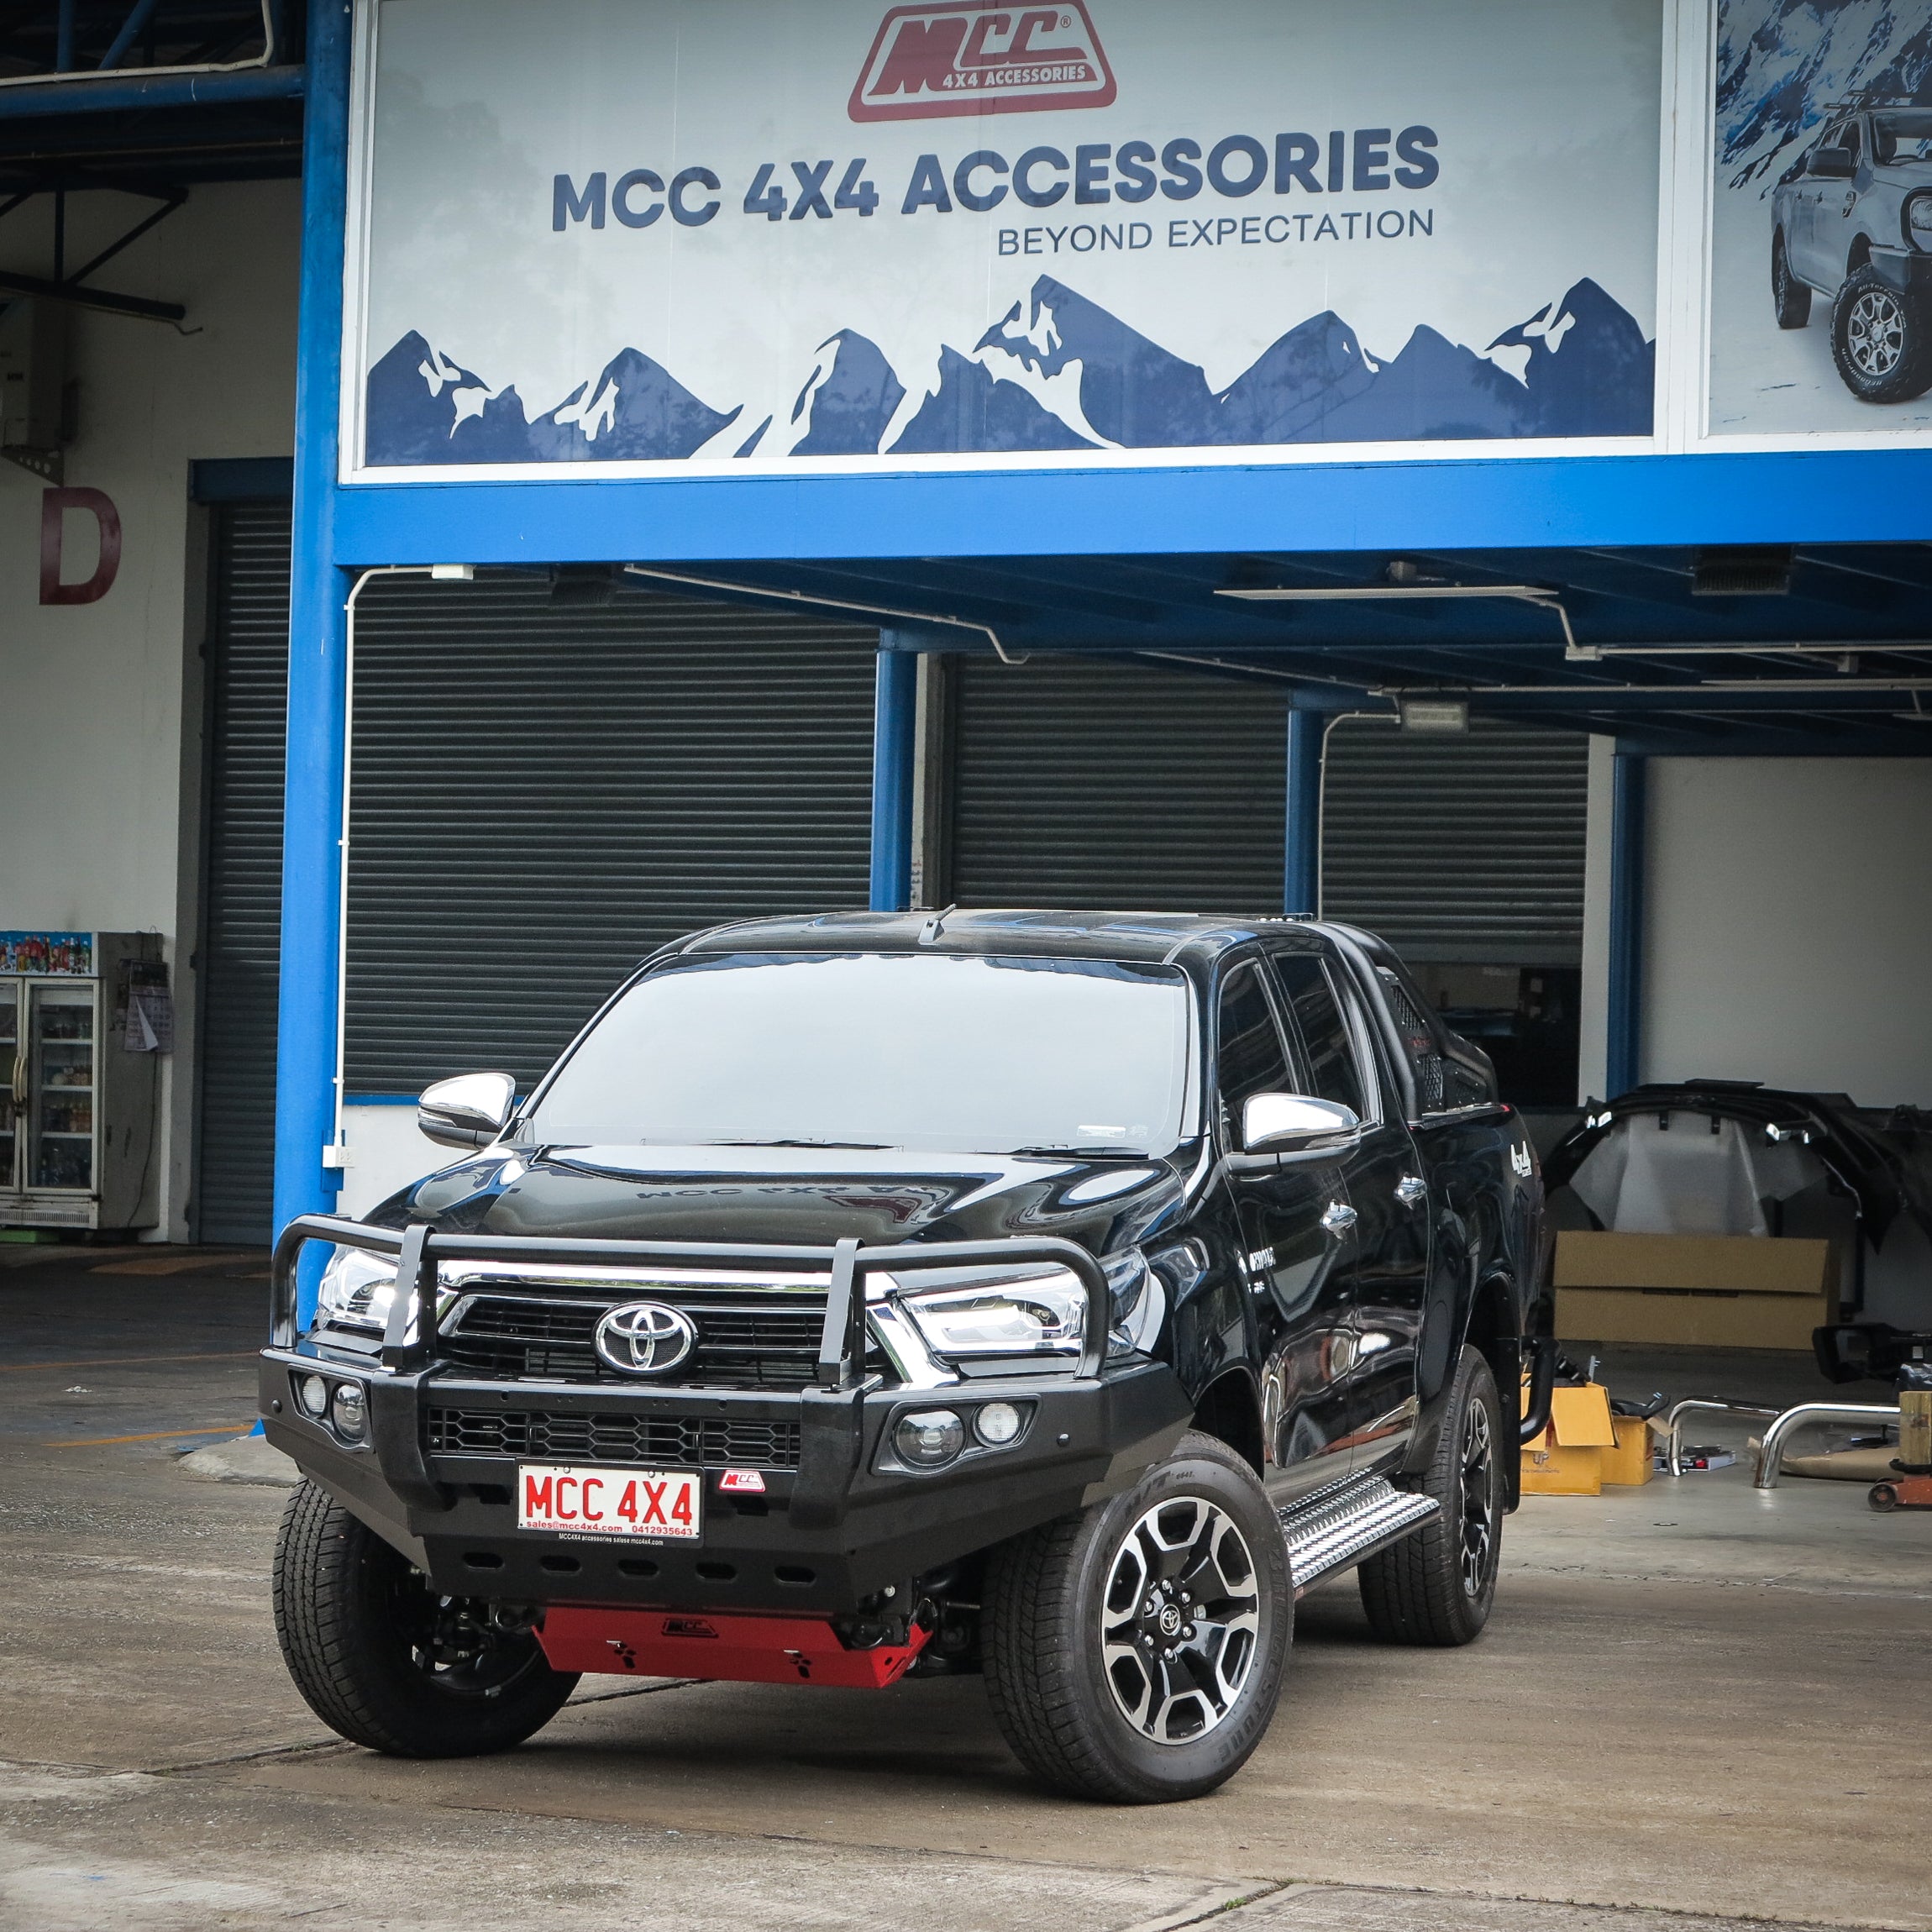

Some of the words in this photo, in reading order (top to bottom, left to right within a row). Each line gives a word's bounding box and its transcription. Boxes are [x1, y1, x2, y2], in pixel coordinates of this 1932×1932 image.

[868, 11, 1088, 96] MCC
[942, 71, 979, 88] 4X4
[984, 65, 1086, 87] ACCESSORIES
[552, 167, 721, 232] MCC
[743, 159, 879, 221] 4X4
[900, 125, 1439, 214] ACCESSORIES
[998, 222, 1152, 255] BEYOND
[1168, 208, 1433, 248] EXPECTATION
[39, 486, 122, 605] D
[526, 1475, 604, 1521] MCC
[617, 1480, 692, 1525] 4X4
[526, 1520, 623, 1532] sales@mcc4x4.com
[632, 1525, 693, 1537] 0412935643
